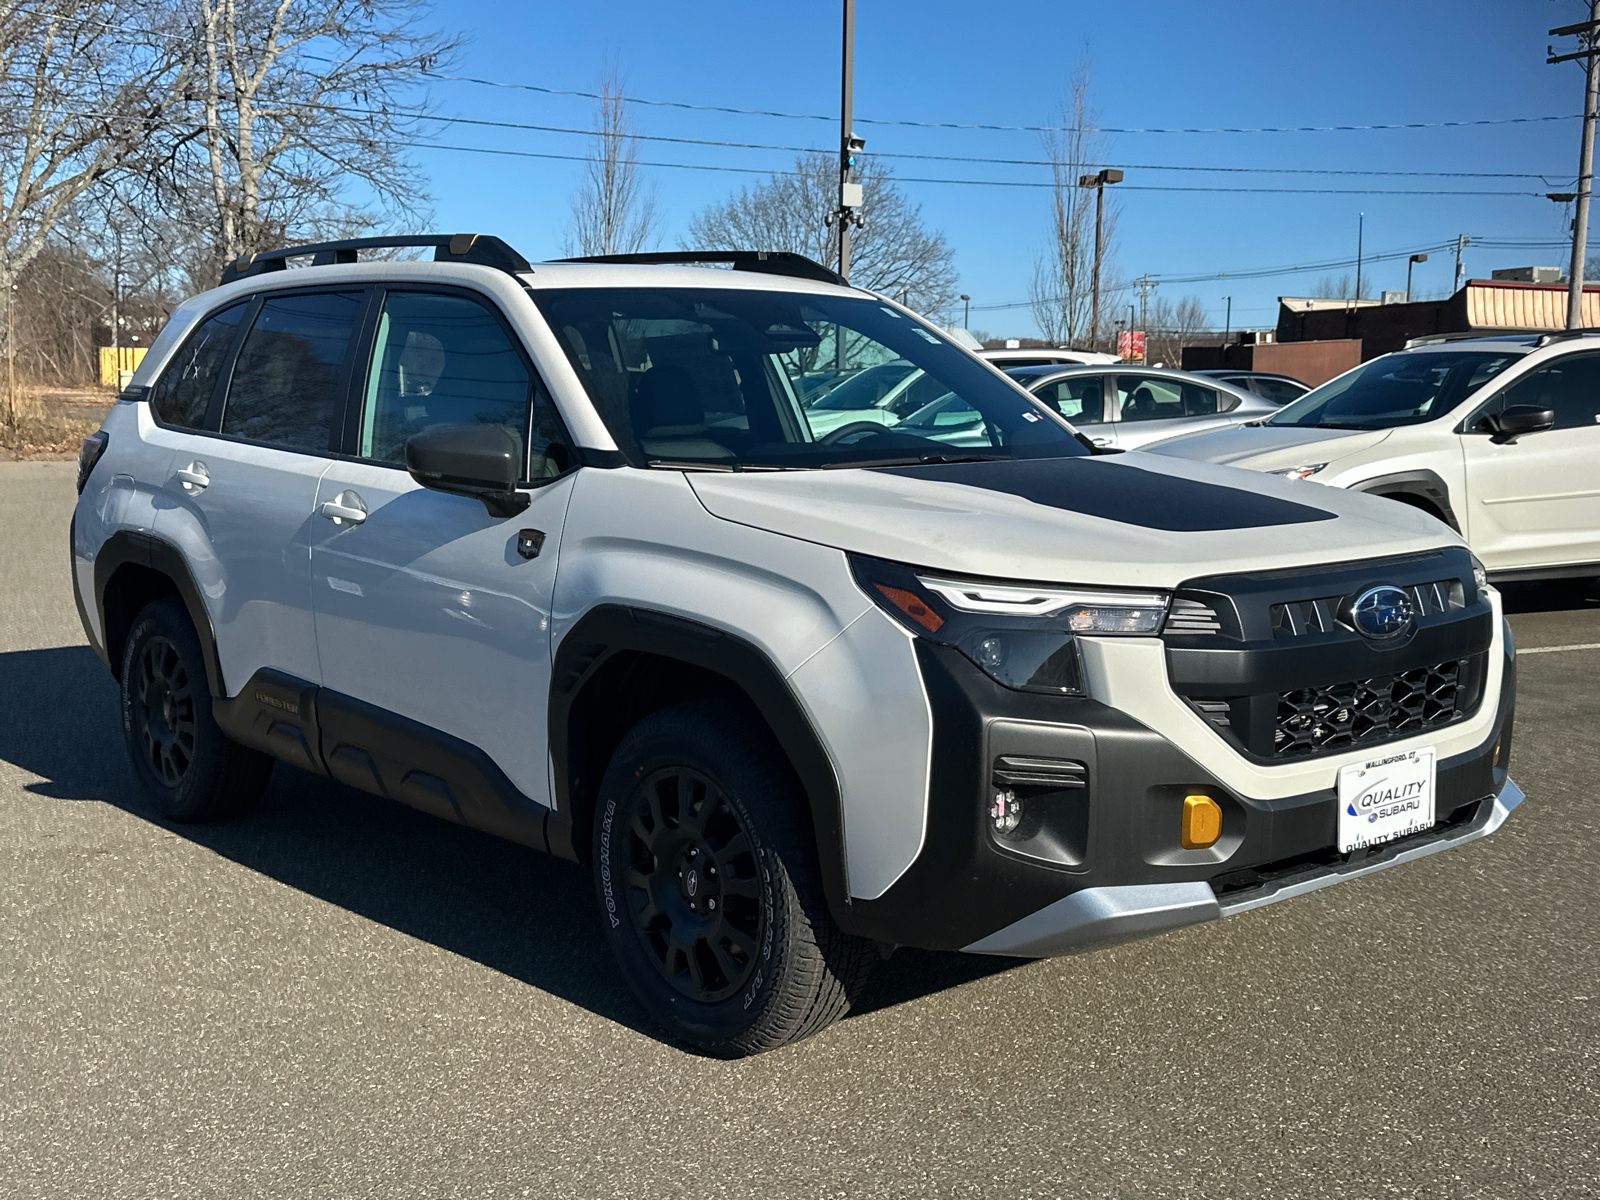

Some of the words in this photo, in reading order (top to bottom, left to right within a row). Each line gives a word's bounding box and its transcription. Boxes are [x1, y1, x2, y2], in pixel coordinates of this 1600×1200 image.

[1408, 751, 1416, 759] CT
[1361, 779, 1426, 807] QUALITY
[1379, 800, 1420, 818] SUBARU
[1346, 834, 1389, 852] QUALITY
[1393, 821, 1432, 839] SUBARU
[600, 799, 617, 928] YOKOHAMA
